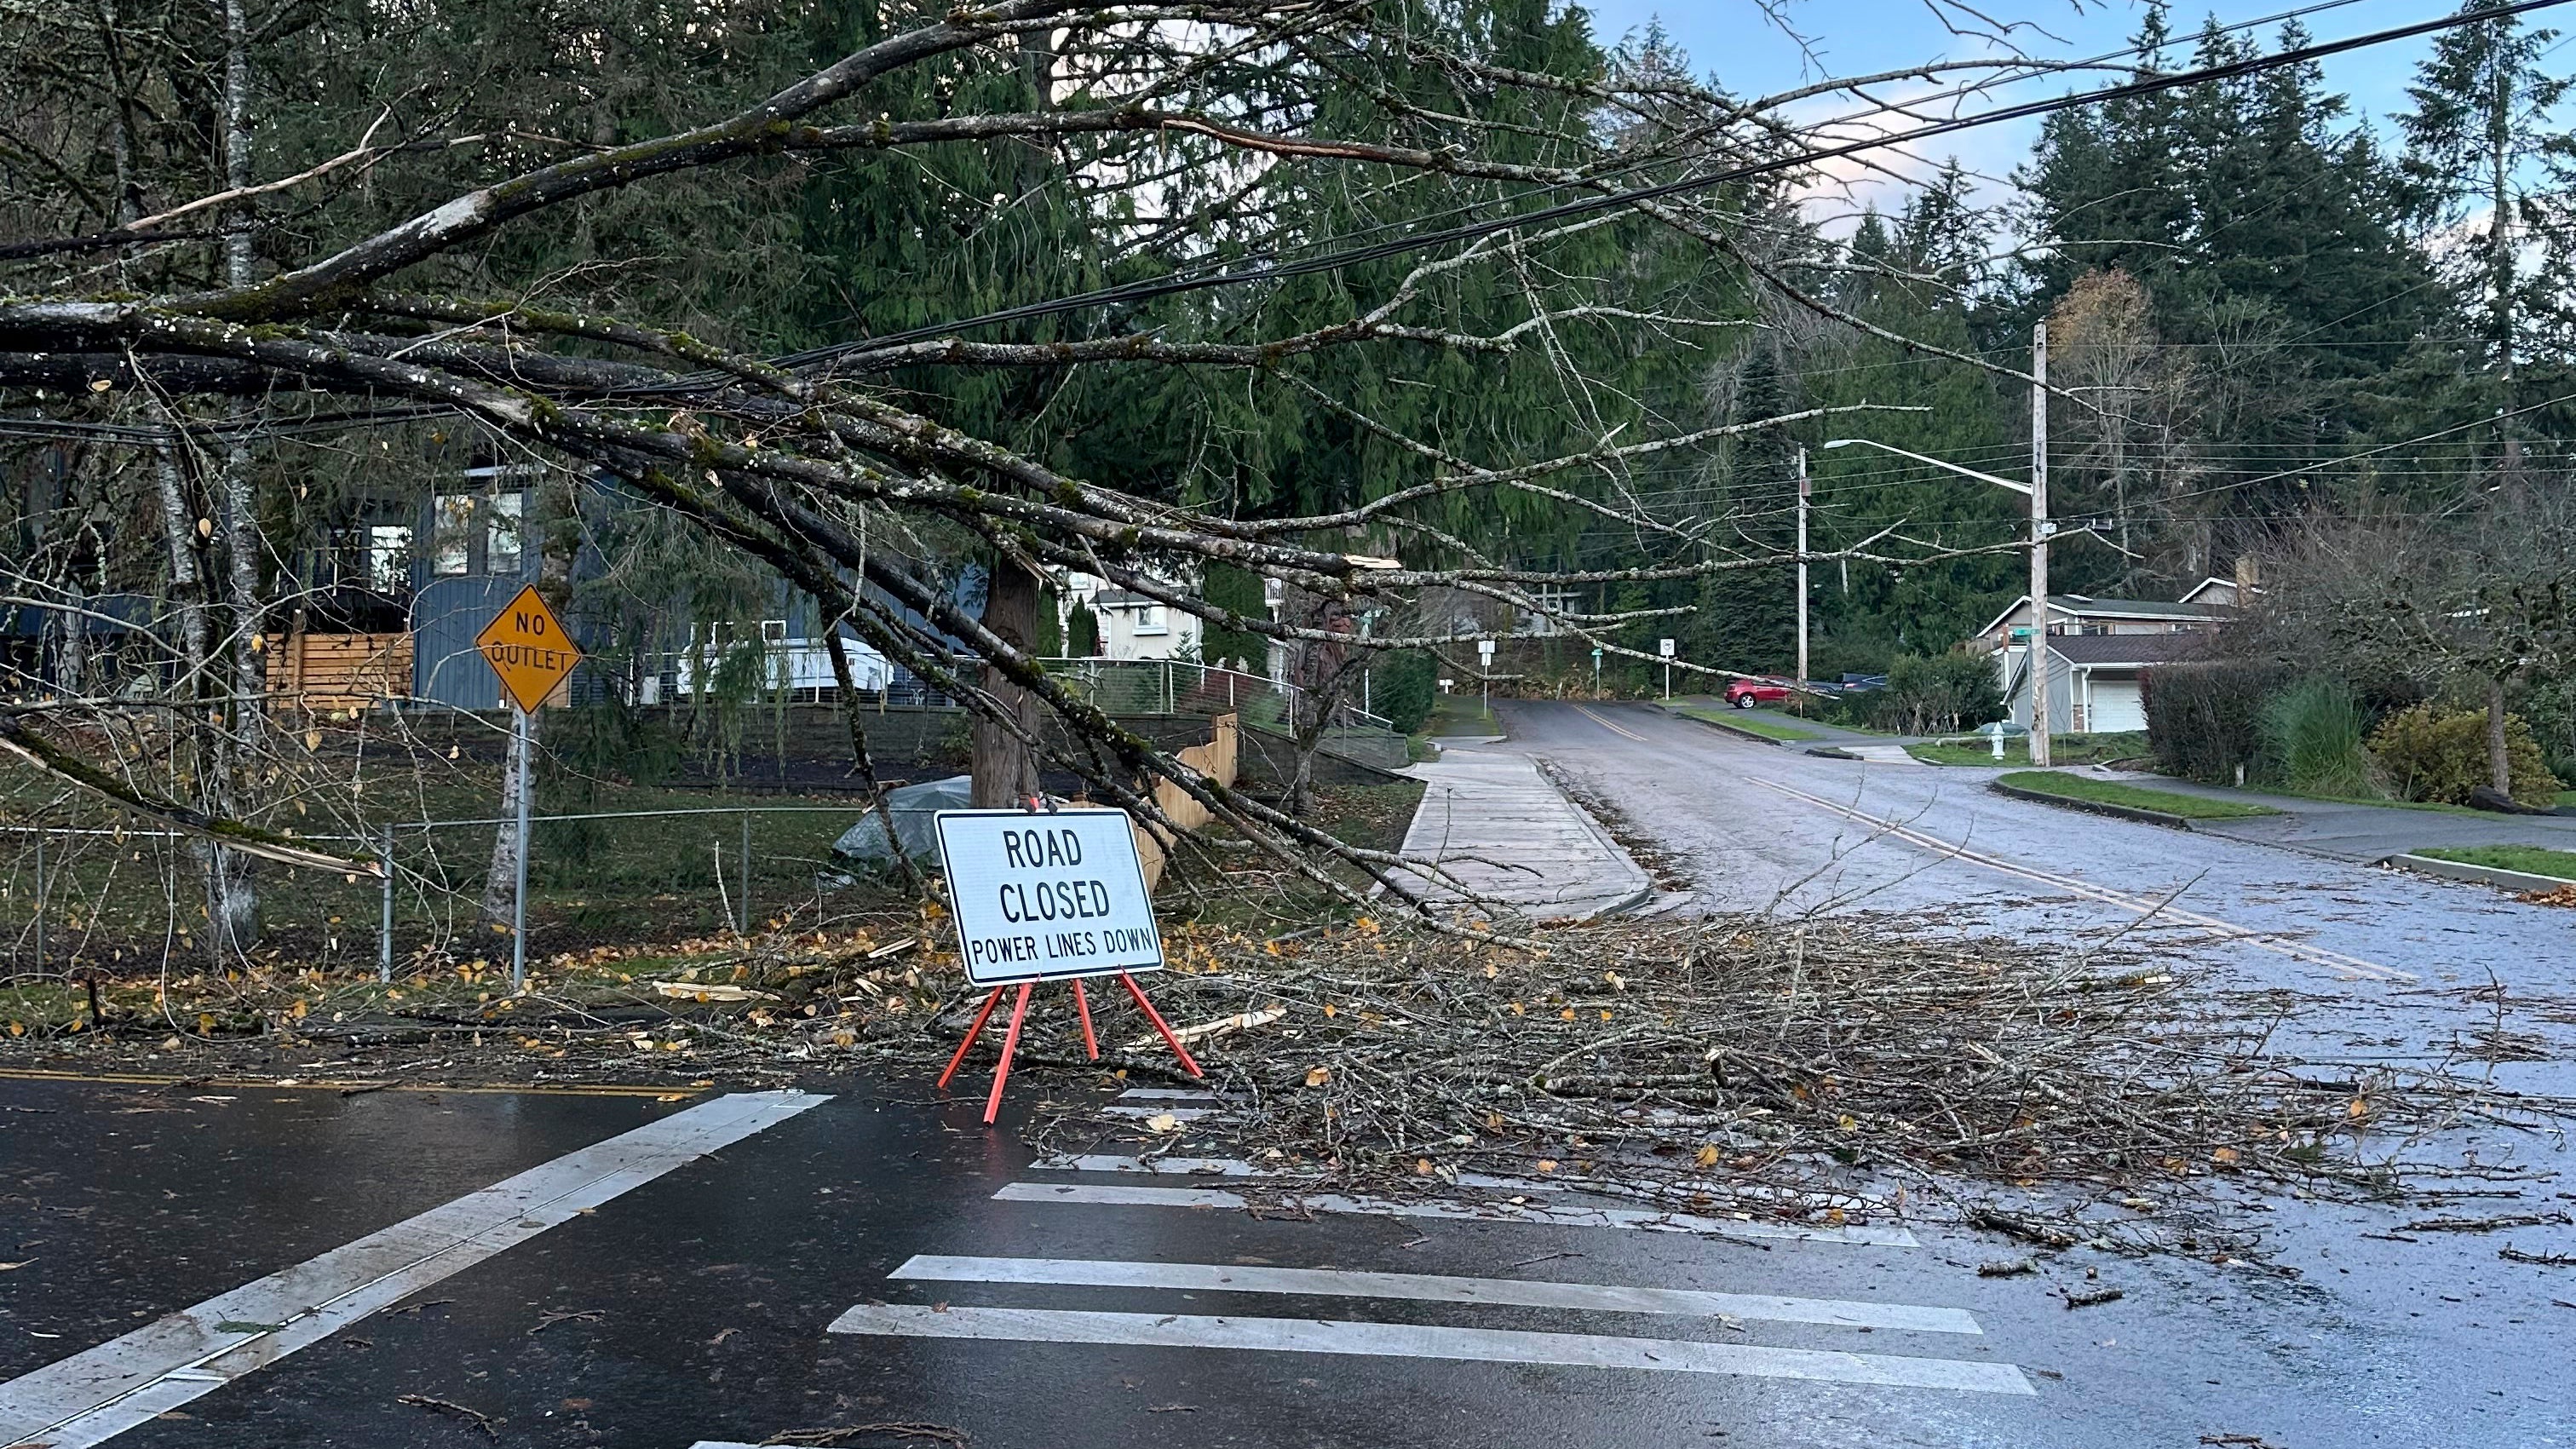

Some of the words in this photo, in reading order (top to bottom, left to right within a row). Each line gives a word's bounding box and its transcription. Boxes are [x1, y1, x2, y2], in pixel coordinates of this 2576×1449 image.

[516, 612, 545, 635] NO
[492, 641, 566, 671] OUTLET
[1003, 829, 1082, 868] ROAD
[999, 880, 1110, 923] CLOSED
[972, 936, 1038, 964] POWER
[1045, 931, 1096, 958] LINES
[1103, 928, 1153, 953] DOWN
